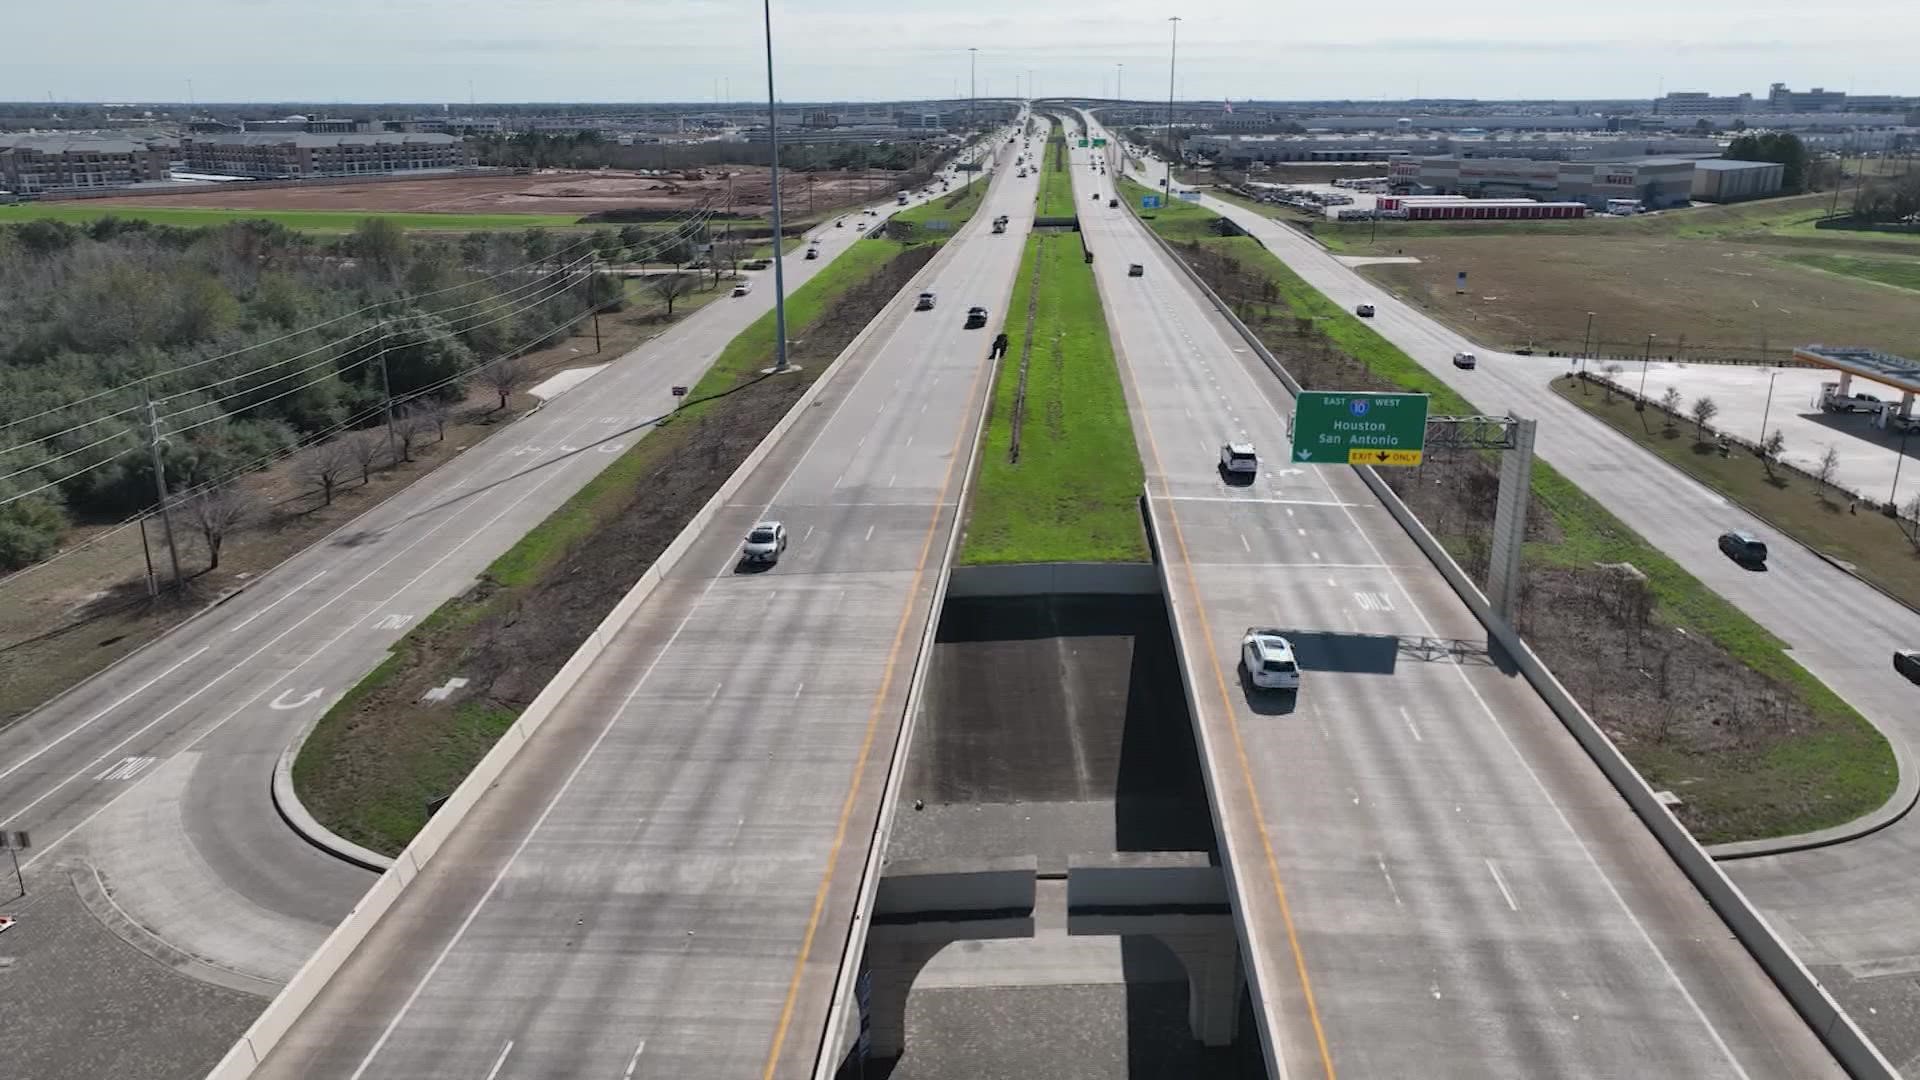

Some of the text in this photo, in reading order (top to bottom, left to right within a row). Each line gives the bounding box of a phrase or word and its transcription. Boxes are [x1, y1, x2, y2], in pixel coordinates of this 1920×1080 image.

[1323, 397, 1401, 413] EAST 10 WEST
[1333, 420, 1386, 431] Houston
[1319, 433, 1399, 446] San Antonio
[1351, 452, 1417, 462] EXIT ONLY
